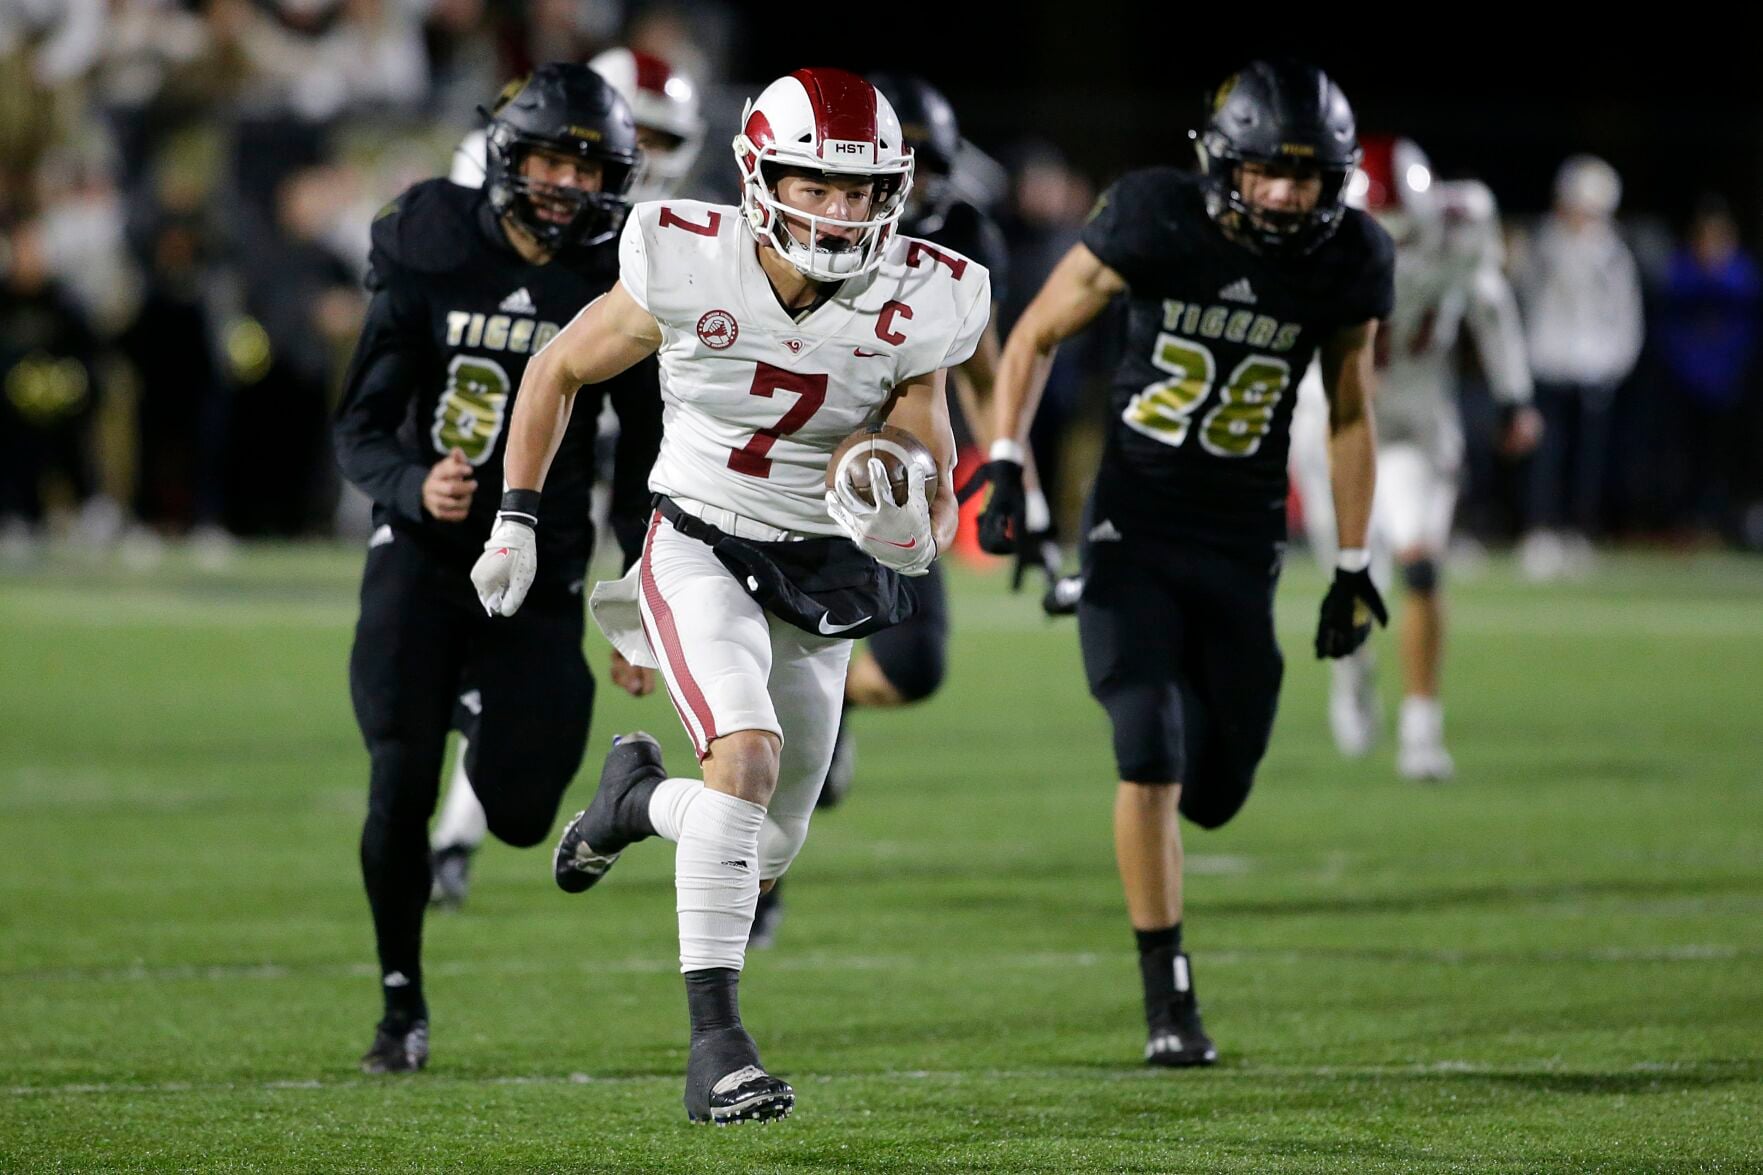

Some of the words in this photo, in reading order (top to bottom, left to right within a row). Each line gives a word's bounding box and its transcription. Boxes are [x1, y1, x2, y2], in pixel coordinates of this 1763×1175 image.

[835, 143, 866, 155] HST
[659, 207, 722, 237] 7
[906, 241, 969, 281] 7
[446, 310, 563, 354] TIGER
[875, 300, 914, 347] C
[1162, 298, 1303, 351] TIGERS
[431, 353, 511, 467] 8
[1121, 331, 1292, 457] 28
[727, 360, 829, 479] 7
